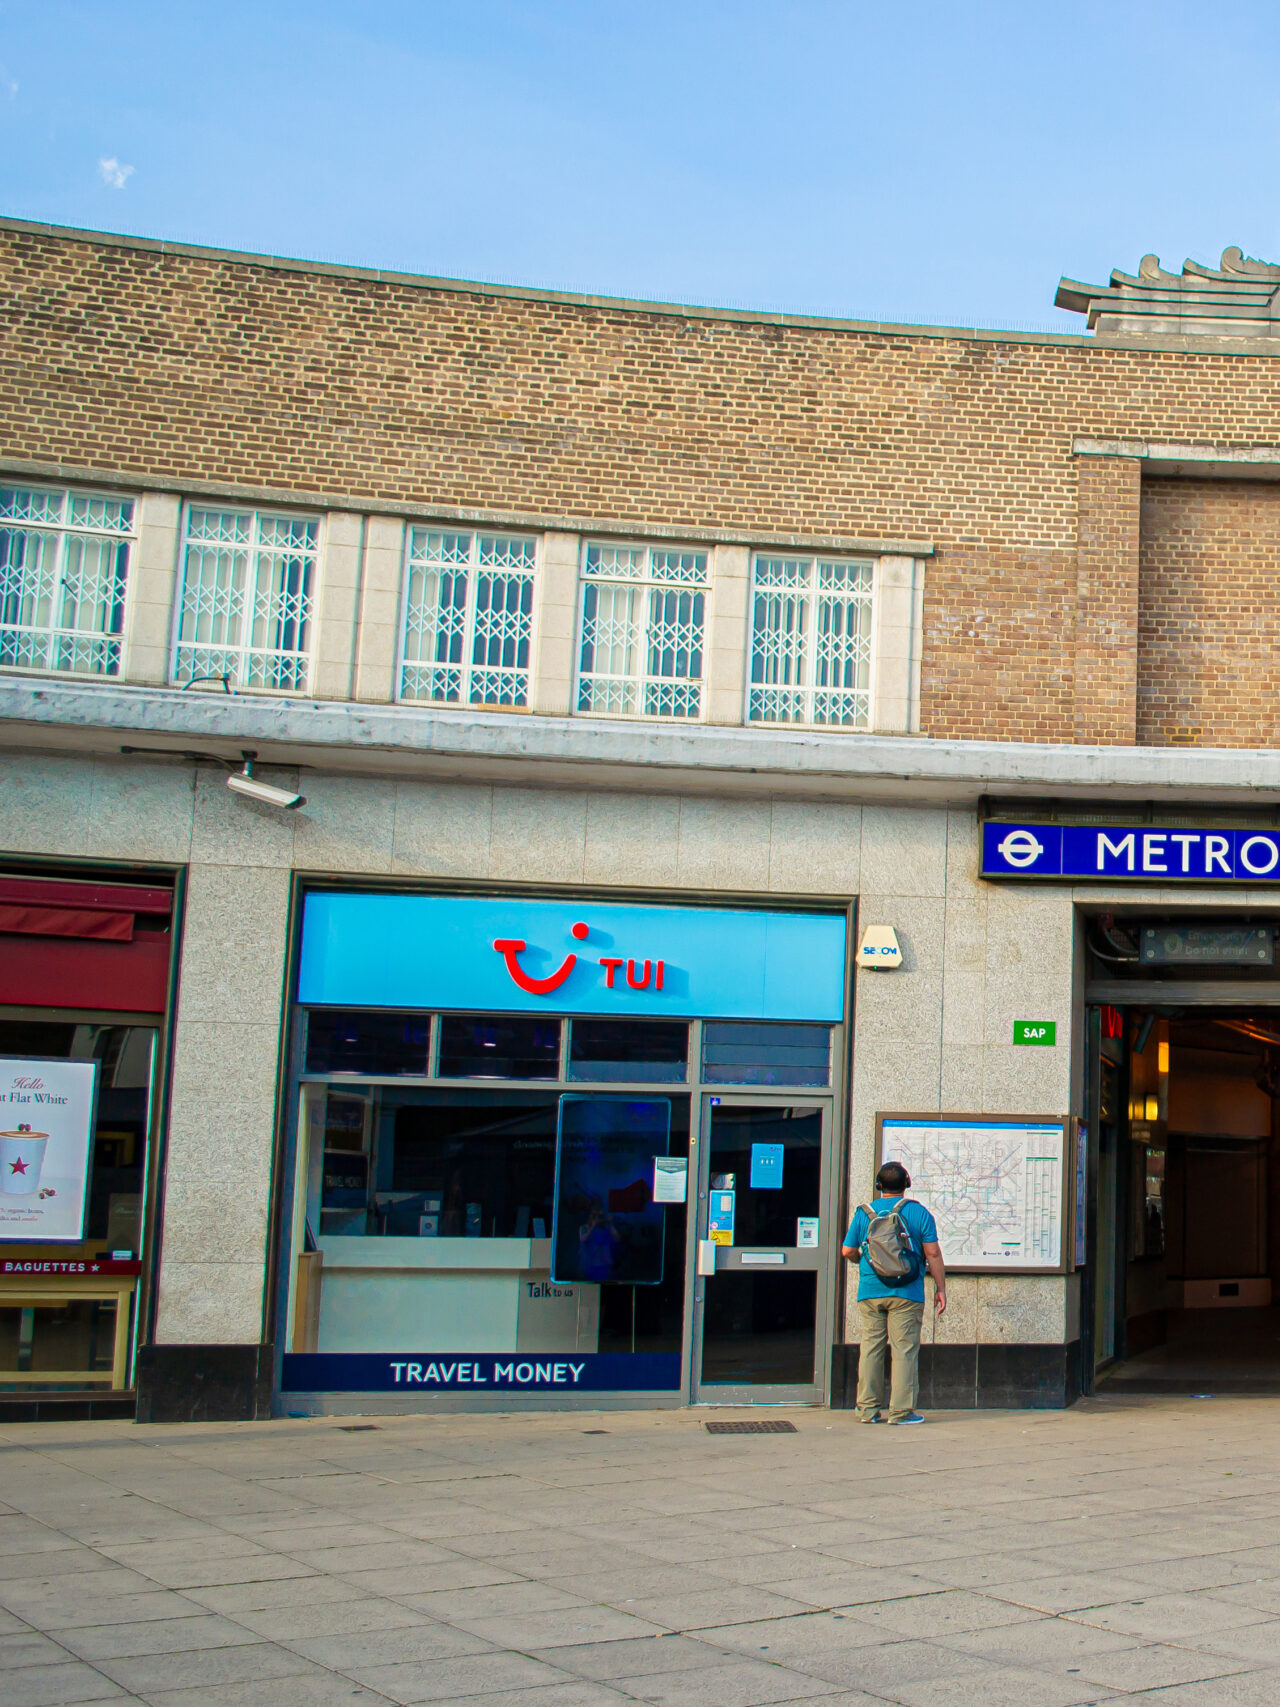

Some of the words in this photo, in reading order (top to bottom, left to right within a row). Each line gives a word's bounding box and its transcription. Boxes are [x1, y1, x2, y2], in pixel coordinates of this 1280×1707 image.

[599, 958, 665, 990] TUI
[1023, 1027, 1047, 1039] SAP
[10, 1076, 46, 1090] Hello
[9, 1091, 31, 1103] Flat
[33, 1092, 69, 1105] White
[4, 1262, 85, 1272] BAGUETTES
[527, 1282, 551, 1298] Talk
[553, 1288, 562, 1296] to
[564, 1289, 573, 1297] us
[390, 1362, 487, 1384] TRAVEL
[494, 1362, 585, 1384] MONEY
